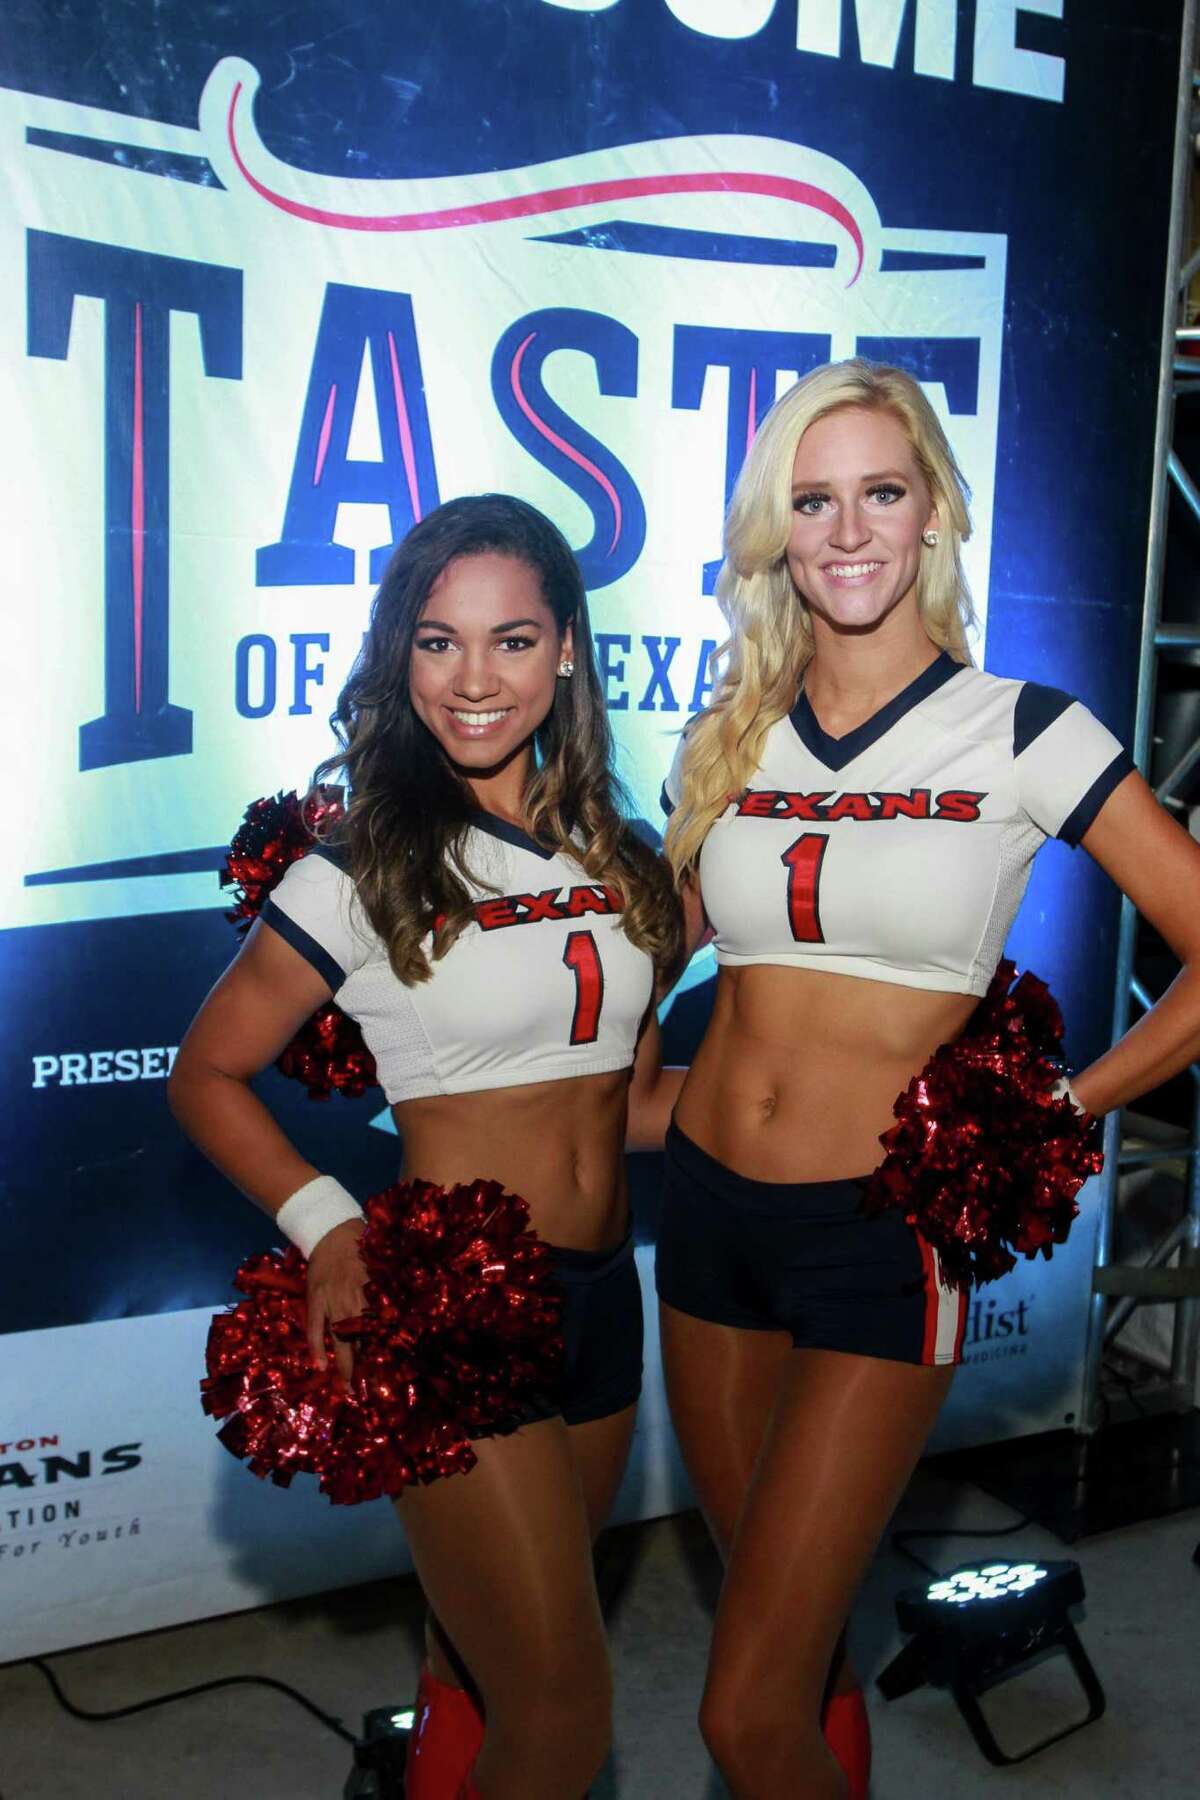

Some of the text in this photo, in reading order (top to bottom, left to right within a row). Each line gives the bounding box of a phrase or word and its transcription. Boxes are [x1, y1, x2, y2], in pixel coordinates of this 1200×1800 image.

[235, 633, 330, 719] OF
[781, 832, 830, 944] 1
[562, 930, 604, 1046] 1
[58, 1516, 142, 1549] Youth
